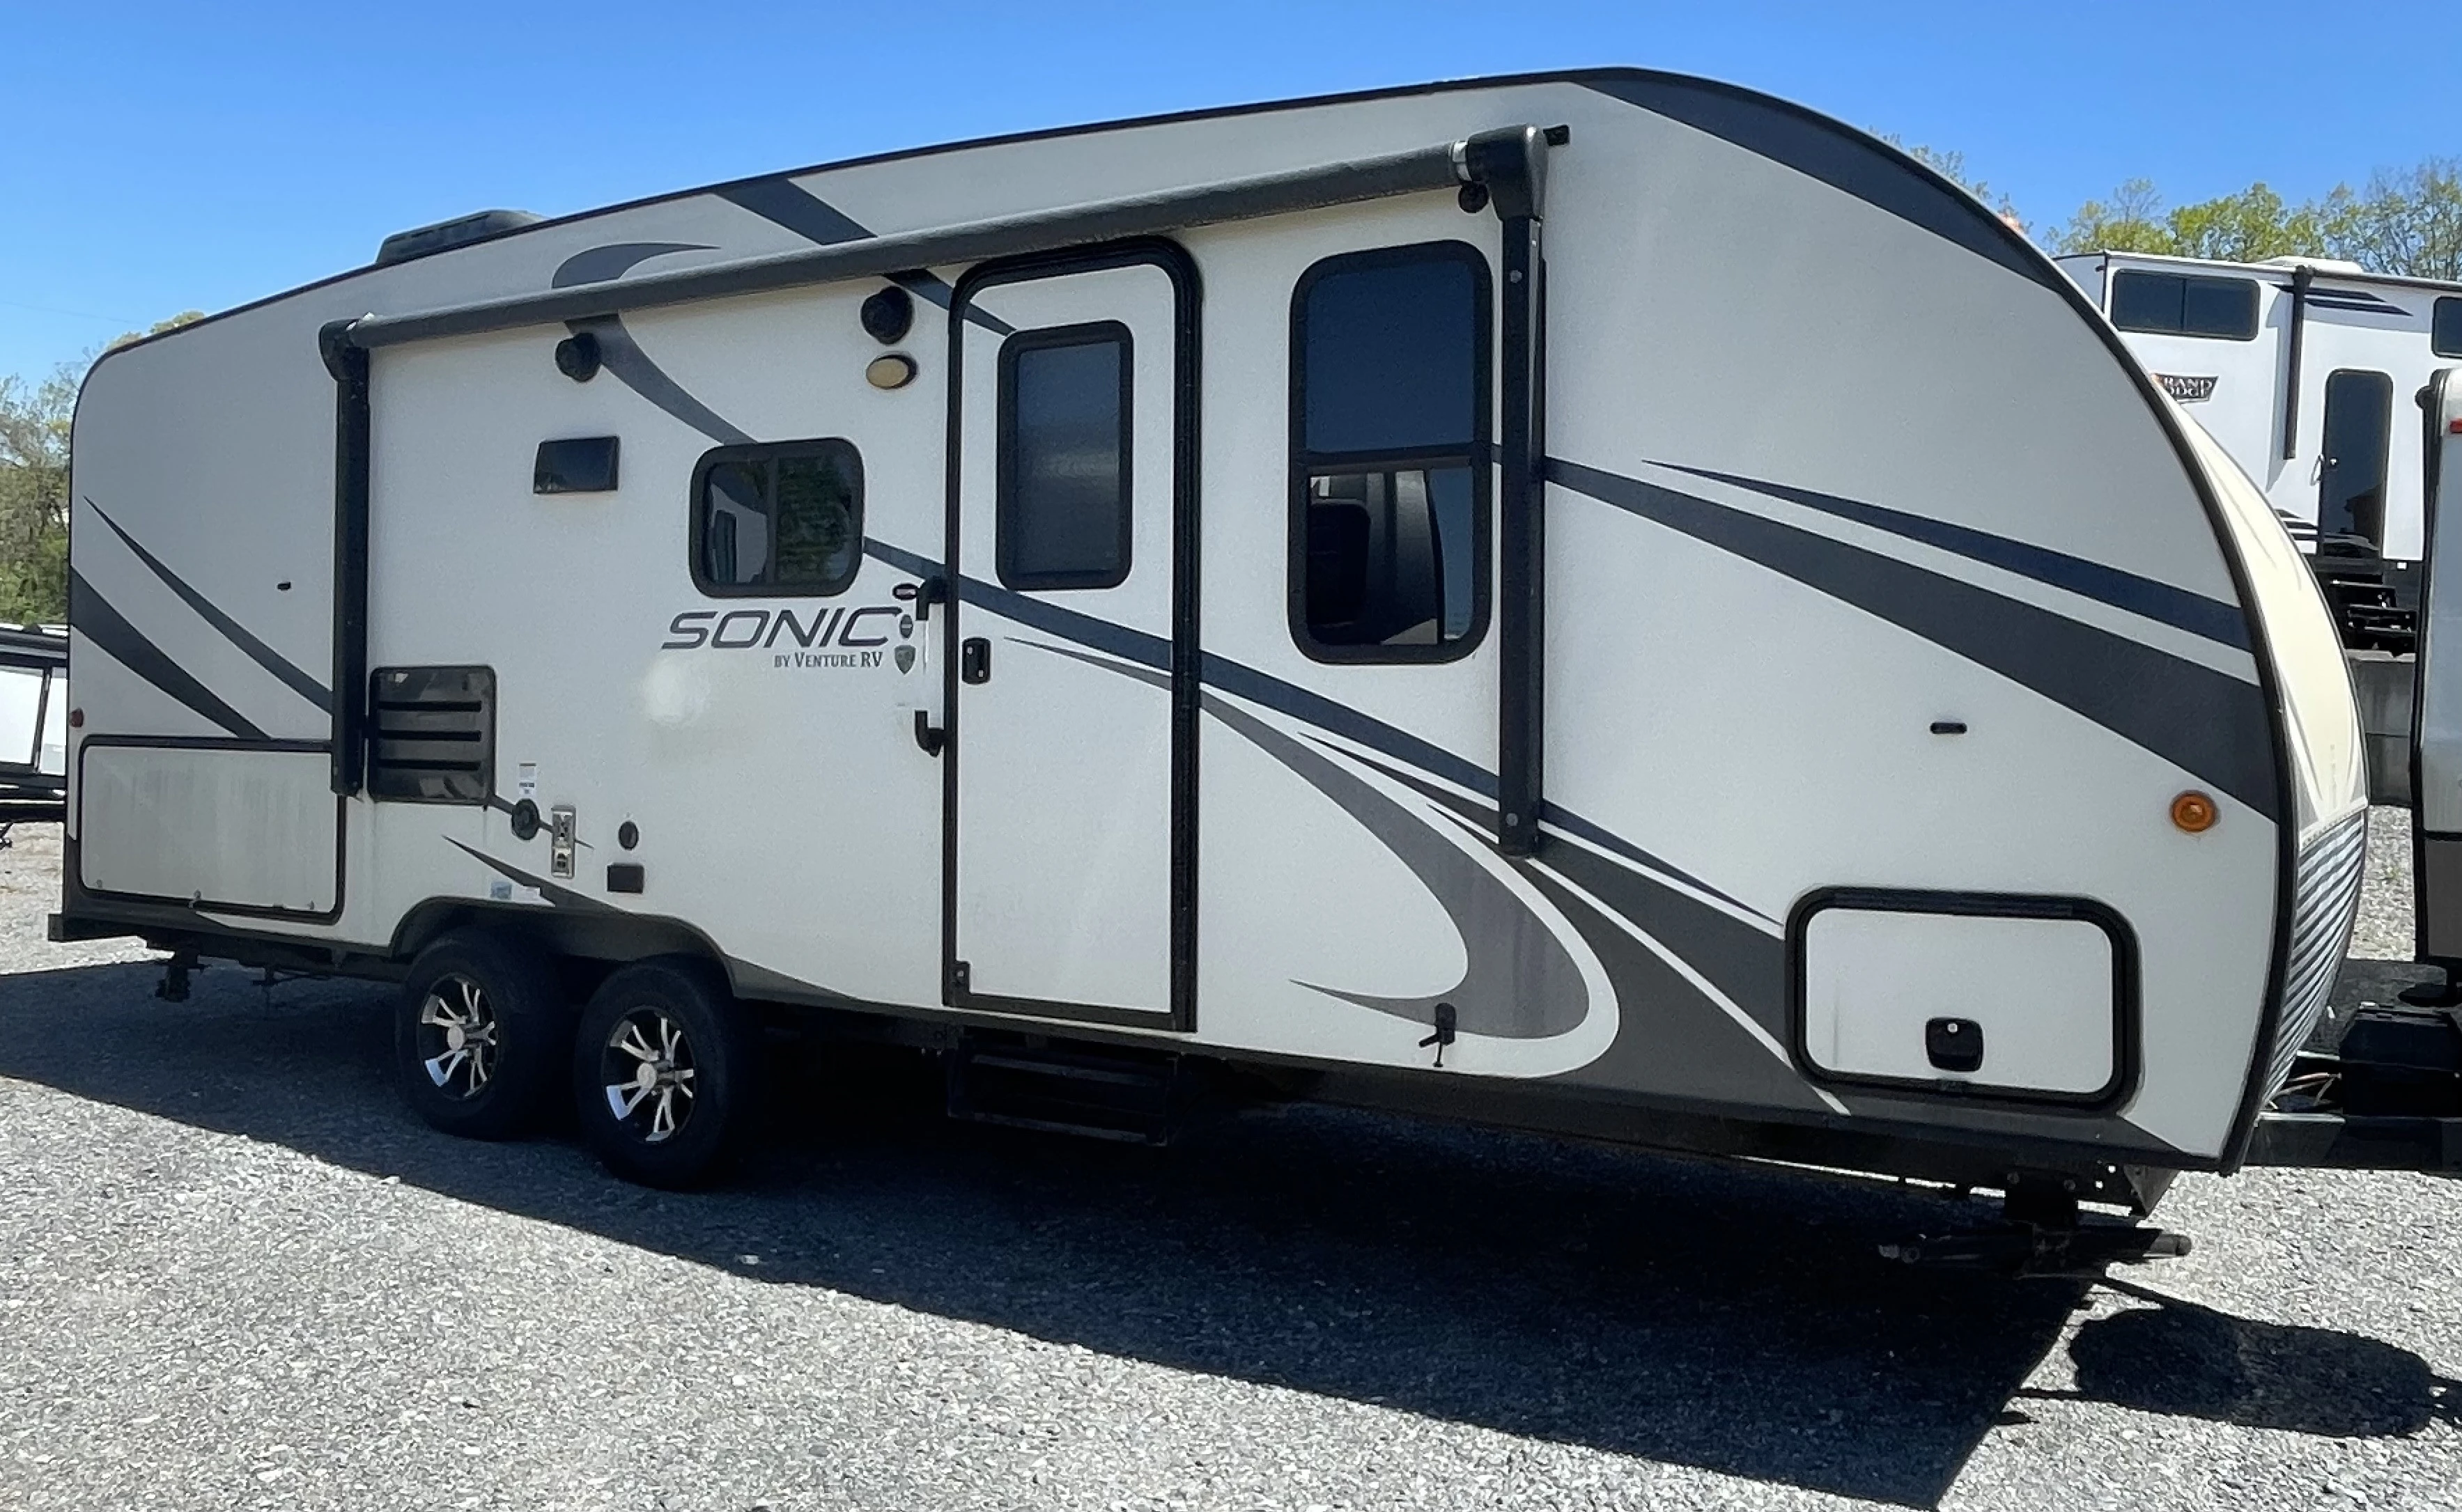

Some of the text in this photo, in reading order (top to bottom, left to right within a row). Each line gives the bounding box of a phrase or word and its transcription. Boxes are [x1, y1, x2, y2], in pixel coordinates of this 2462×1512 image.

[2160, 377, 2213, 389] RAND
[2170, 387, 2207, 397] DGE
[662, 607, 902, 649] SONIC
[774, 651, 883, 668] BY VENTURE RV
